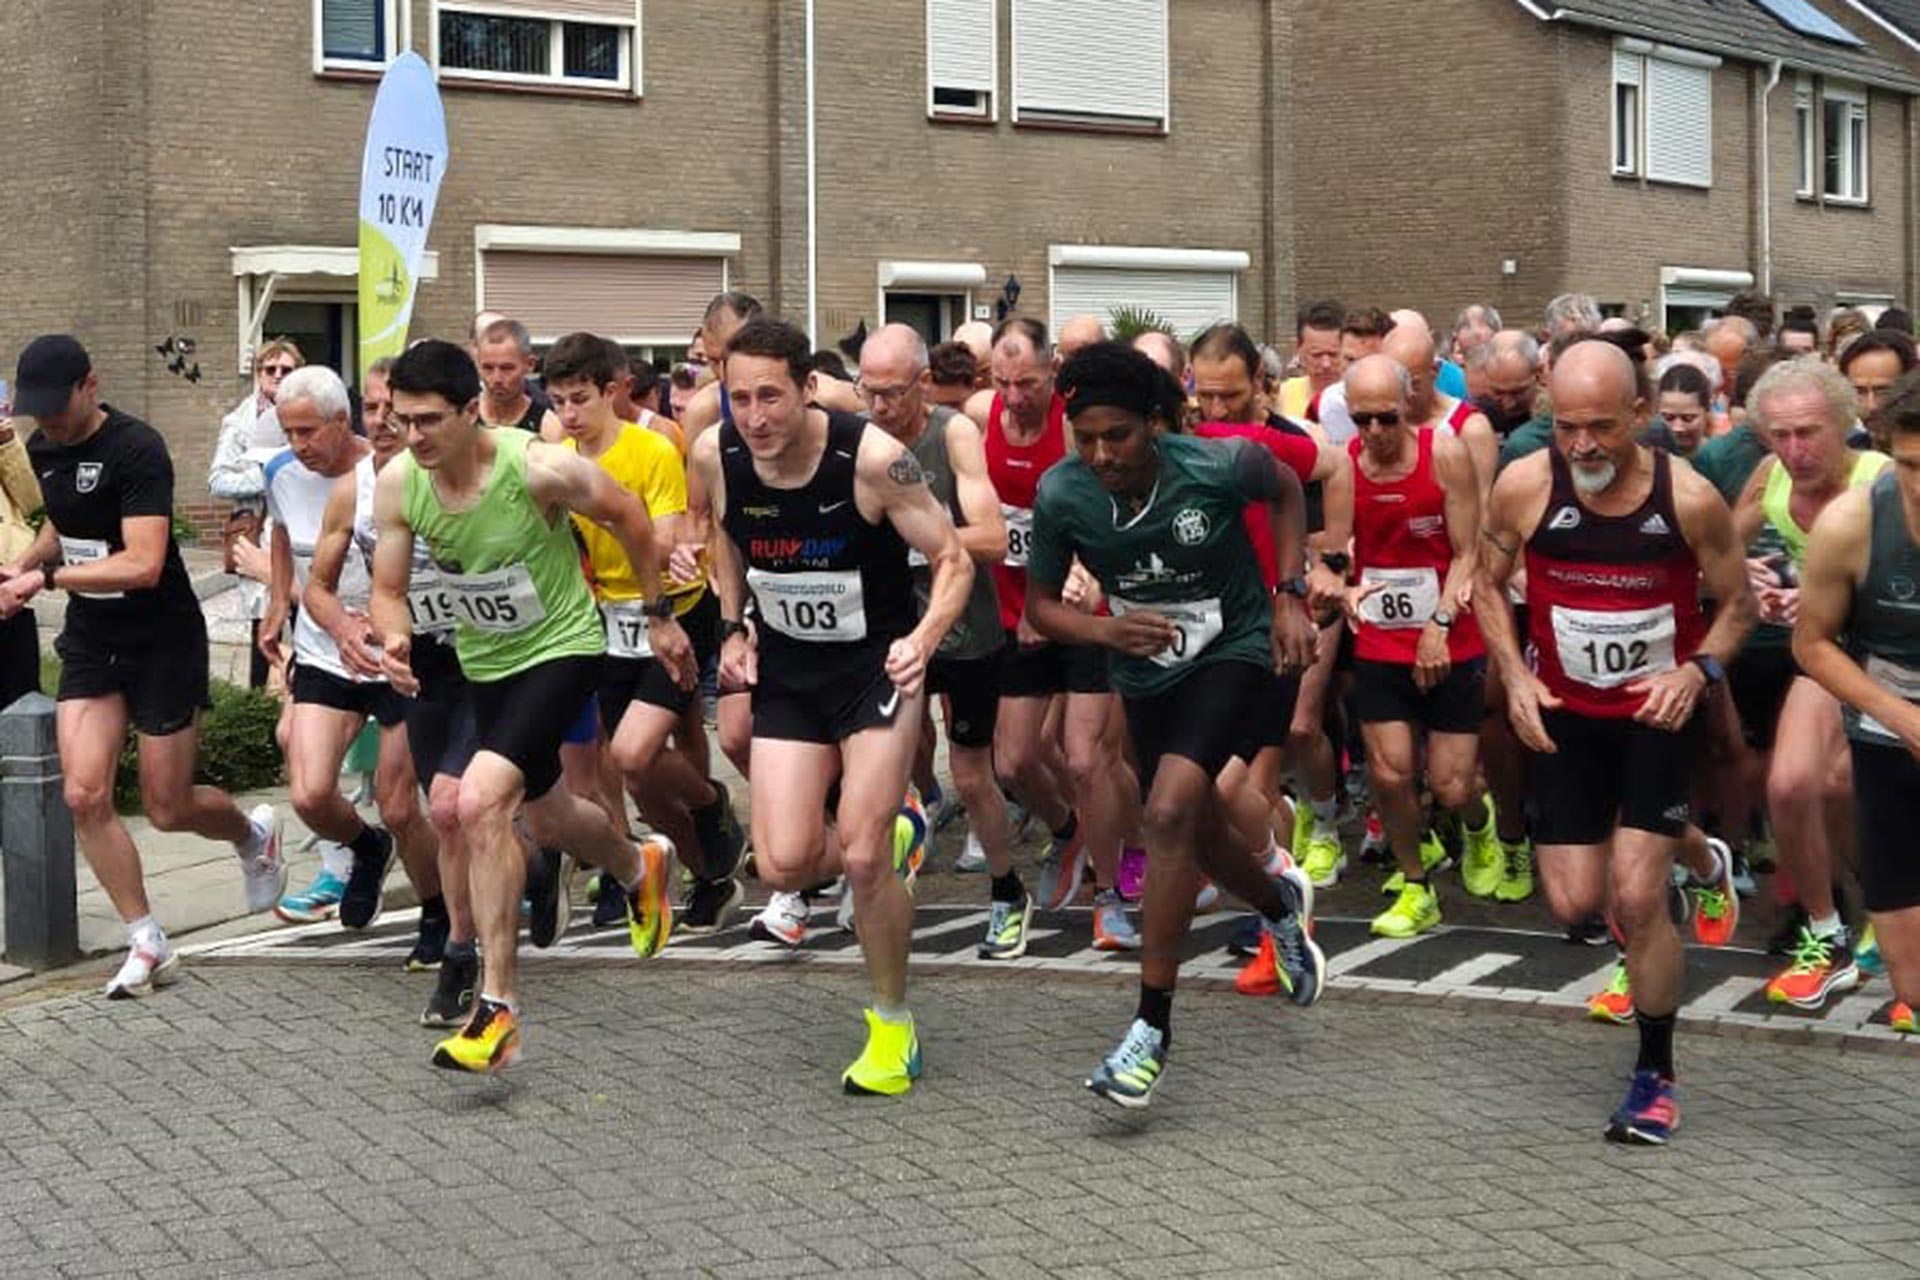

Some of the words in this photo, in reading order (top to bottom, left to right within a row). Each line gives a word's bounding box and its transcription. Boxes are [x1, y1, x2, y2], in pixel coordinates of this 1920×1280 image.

[384, 147, 434, 183] START
[378, 193, 396, 225] 10
[401, 195, 424, 229] KM
[458, 594, 518, 623] 105
[778, 599, 837, 630] 103
[1381, 592, 1413, 619] 86
[1581, 639, 1649, 674] 102
